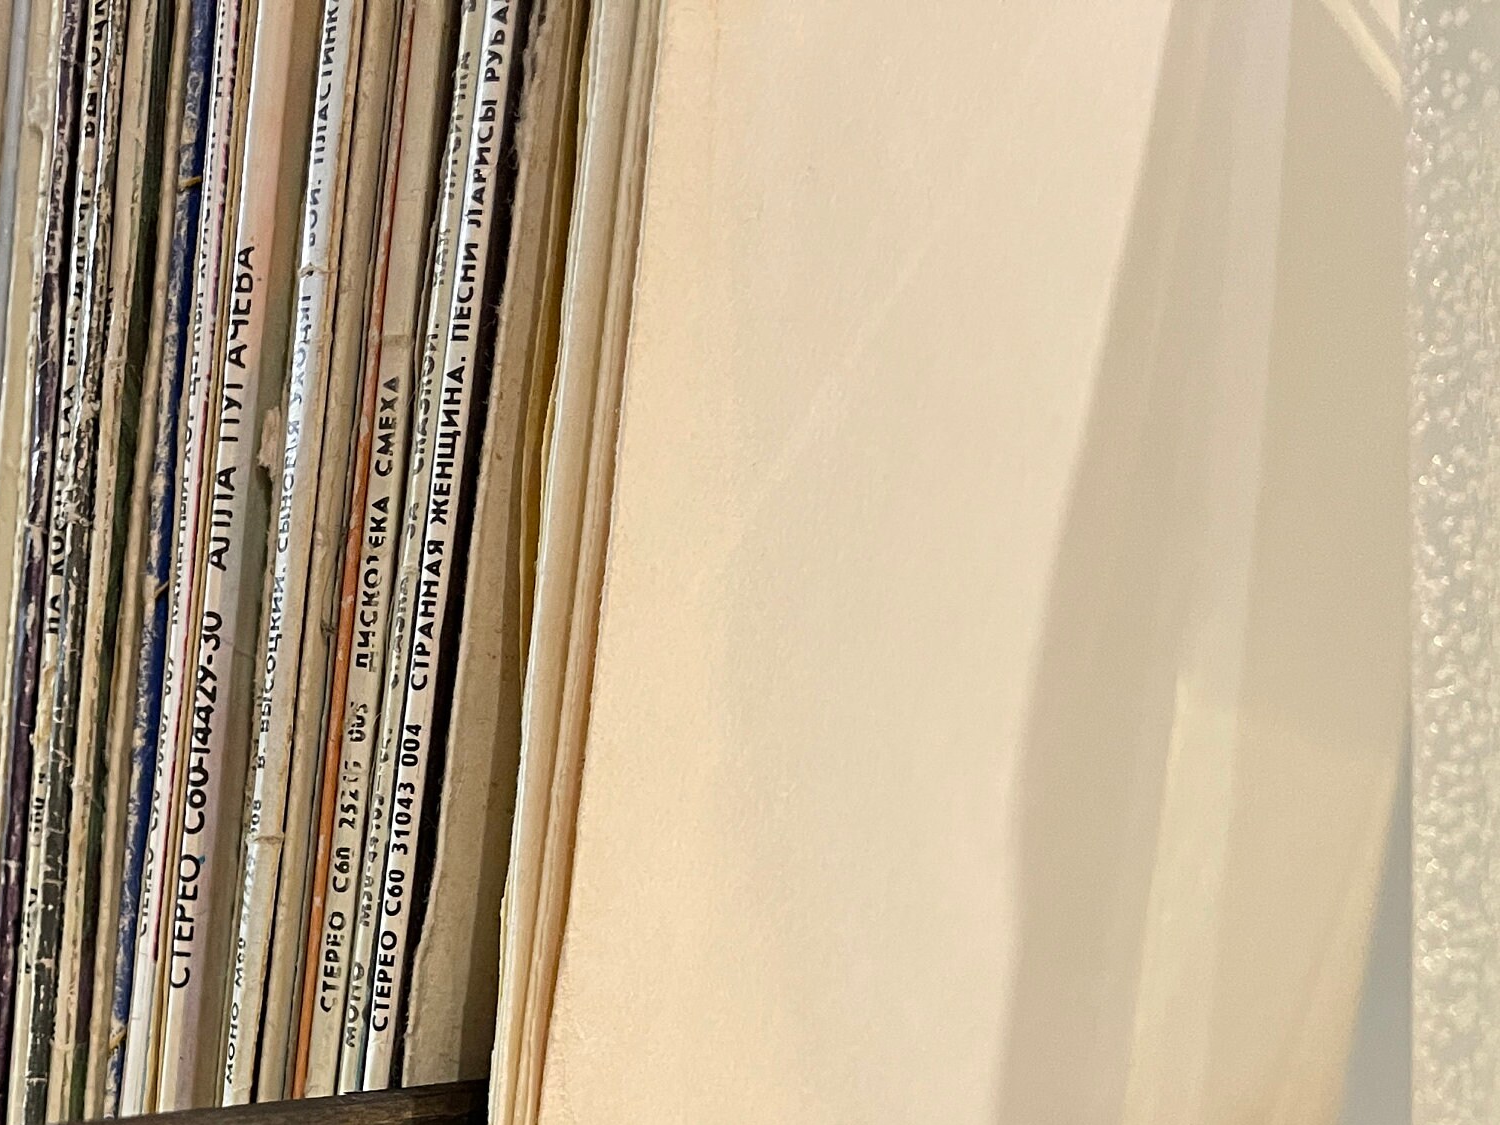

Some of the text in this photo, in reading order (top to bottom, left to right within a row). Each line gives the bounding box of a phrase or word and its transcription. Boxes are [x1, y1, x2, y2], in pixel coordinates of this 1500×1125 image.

[205, 465, 237, 572] АЛЛА
[217, 244, 258, 442] ПУГАЧЕВА
[223, 1001, 241, 1084] МОНО
[312, 0, 340, 164] ПЛАСТИНК
[369, 0, 510, 1032] СТЕРЕО С60 31043 004 СТРАННАЯ ЖЕНЩИНА. ПЕСНИ ЛАРИСЫ РУБА
[317, 910, 348, 1013] СТЕРЕО
[372, 374, 400, 477] СМЕХА
[167, 853, 202, 989] СТЕРЕО
